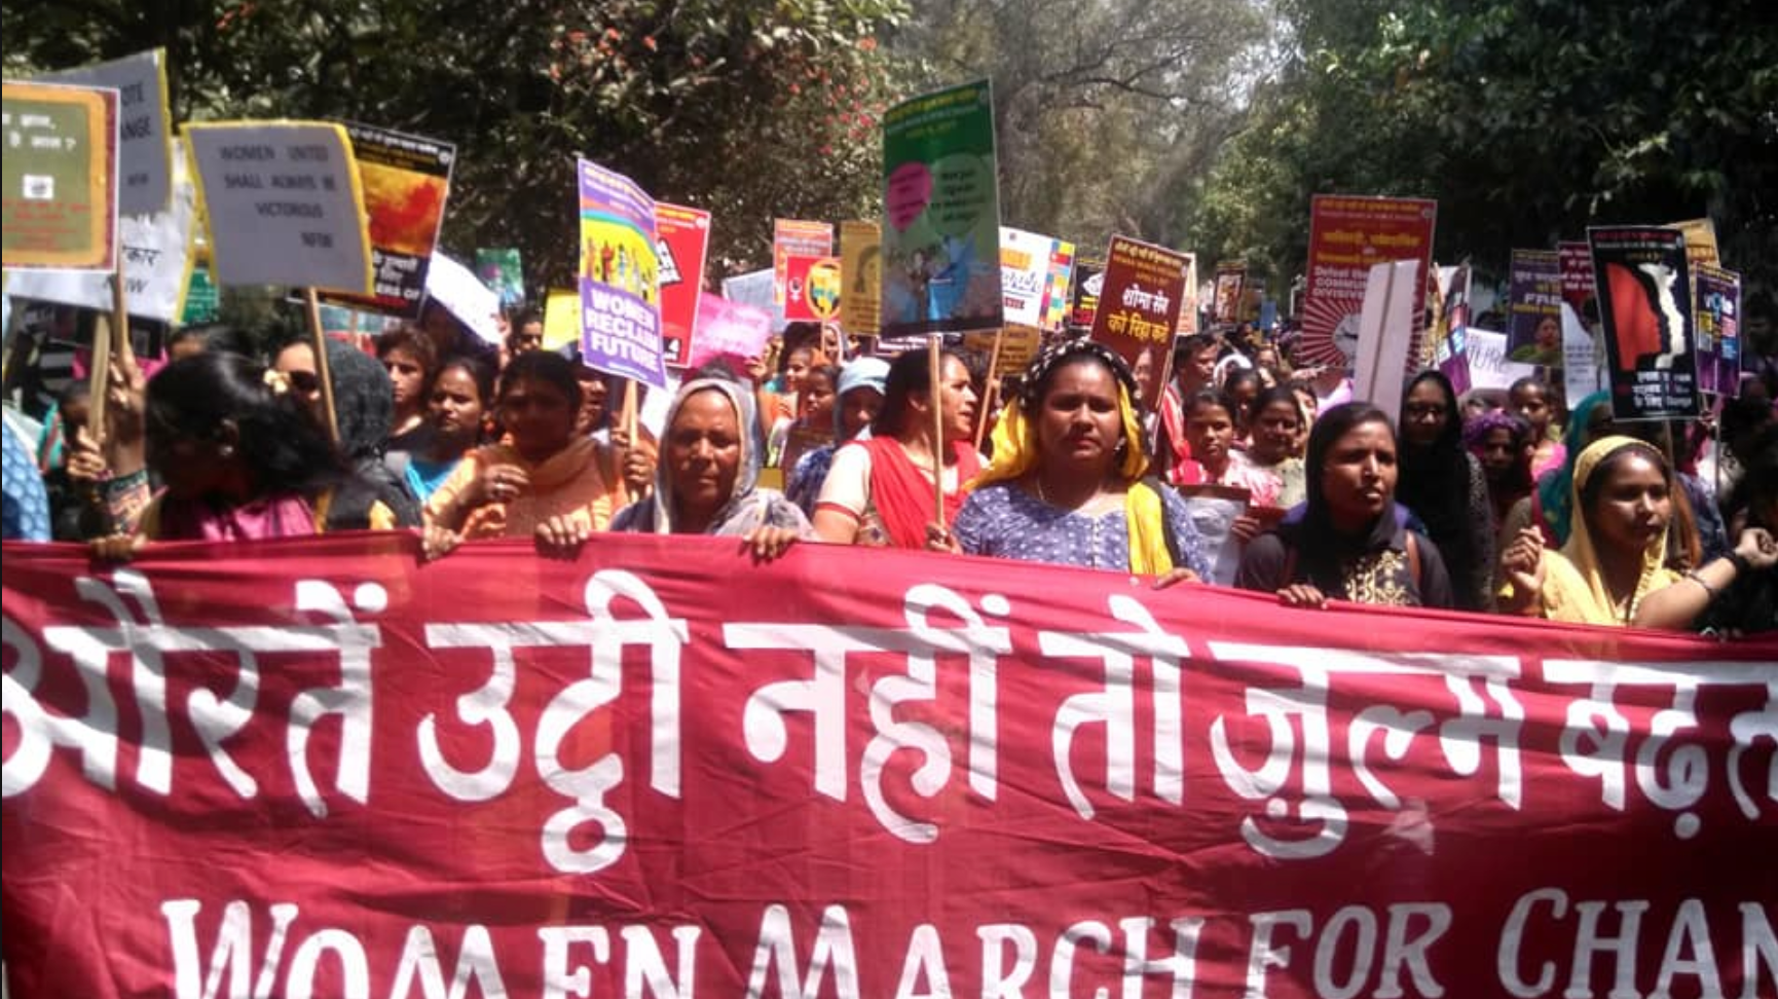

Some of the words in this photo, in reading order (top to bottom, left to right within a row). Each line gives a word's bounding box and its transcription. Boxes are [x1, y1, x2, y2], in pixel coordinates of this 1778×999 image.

[220, 144, 275, 160] WOMEN
[224, 173, 264, 189] SHALL
[271, 174, 317, 189] ALWAYS
[255, 202, 324, 218] VICTORIOUS
[1313, 266, 1349, 278] Defeat
[591, 288, 656, 331] WOMEN
[1122, 284, 1152, 310] शोमा
[1107, 310, 1126, 336] को
[591, 331, 660, 373] FUTURE
[722, 583, 1012, 843] नहीं
[1039, 594, 1193, 821] तो
[1209, 641, 1525, 860] ज़ुल्म
[161, 899, 702, 999] WOMEN
[744, 903, 1204, 999] MARCH
[1246, 901, 1453, 999] FOR
